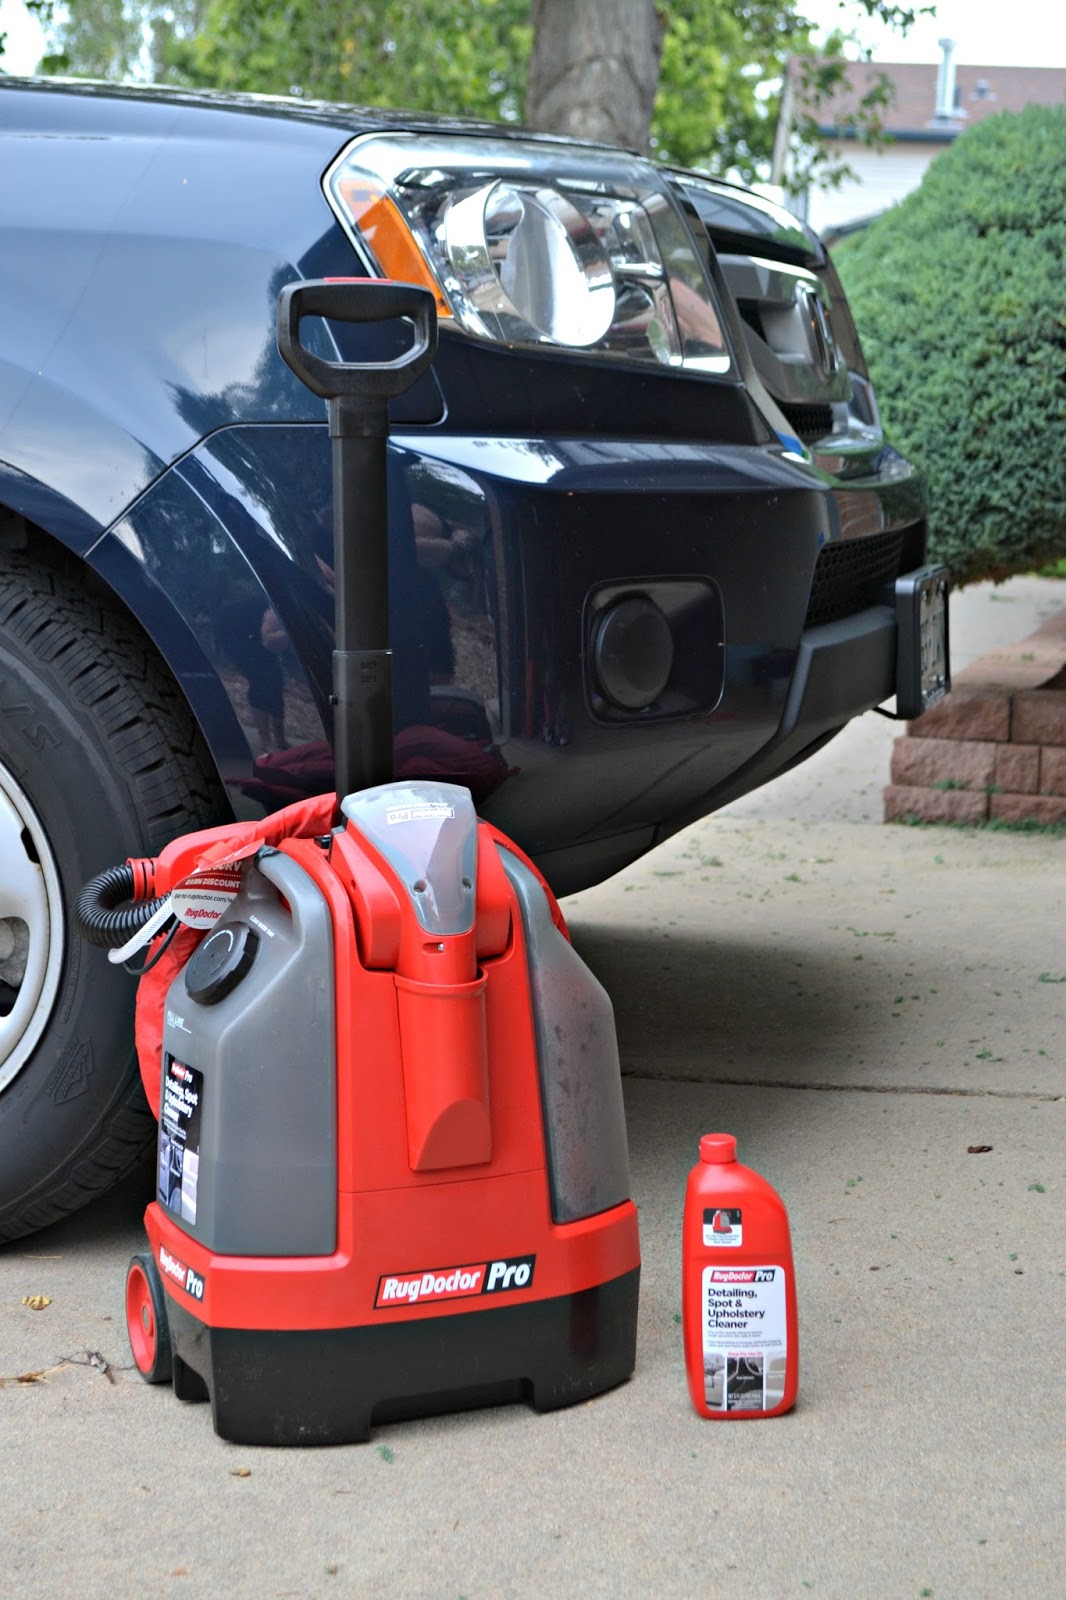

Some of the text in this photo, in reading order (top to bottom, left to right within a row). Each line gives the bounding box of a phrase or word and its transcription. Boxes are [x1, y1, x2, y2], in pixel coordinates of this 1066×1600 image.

[202, 878, 241, 888] DISCOUNT
[184, 907, 222, 920] RugDoctor
[184, 1088, 198, 1106] Spot
[382, 1261, 531, 1302] RugDoctor Pro
[713, 1270, 774, 1282] RugDoctor Pro
[186, 1268, 204, 1298] Pro
[707, 1288, 758, 1299] Detailing,
[707, 1298, 743, 1309] Spot &
[707, 1308, 766, 1319] Upholstery
[707, 1319, 748, 1329] Cleaner
